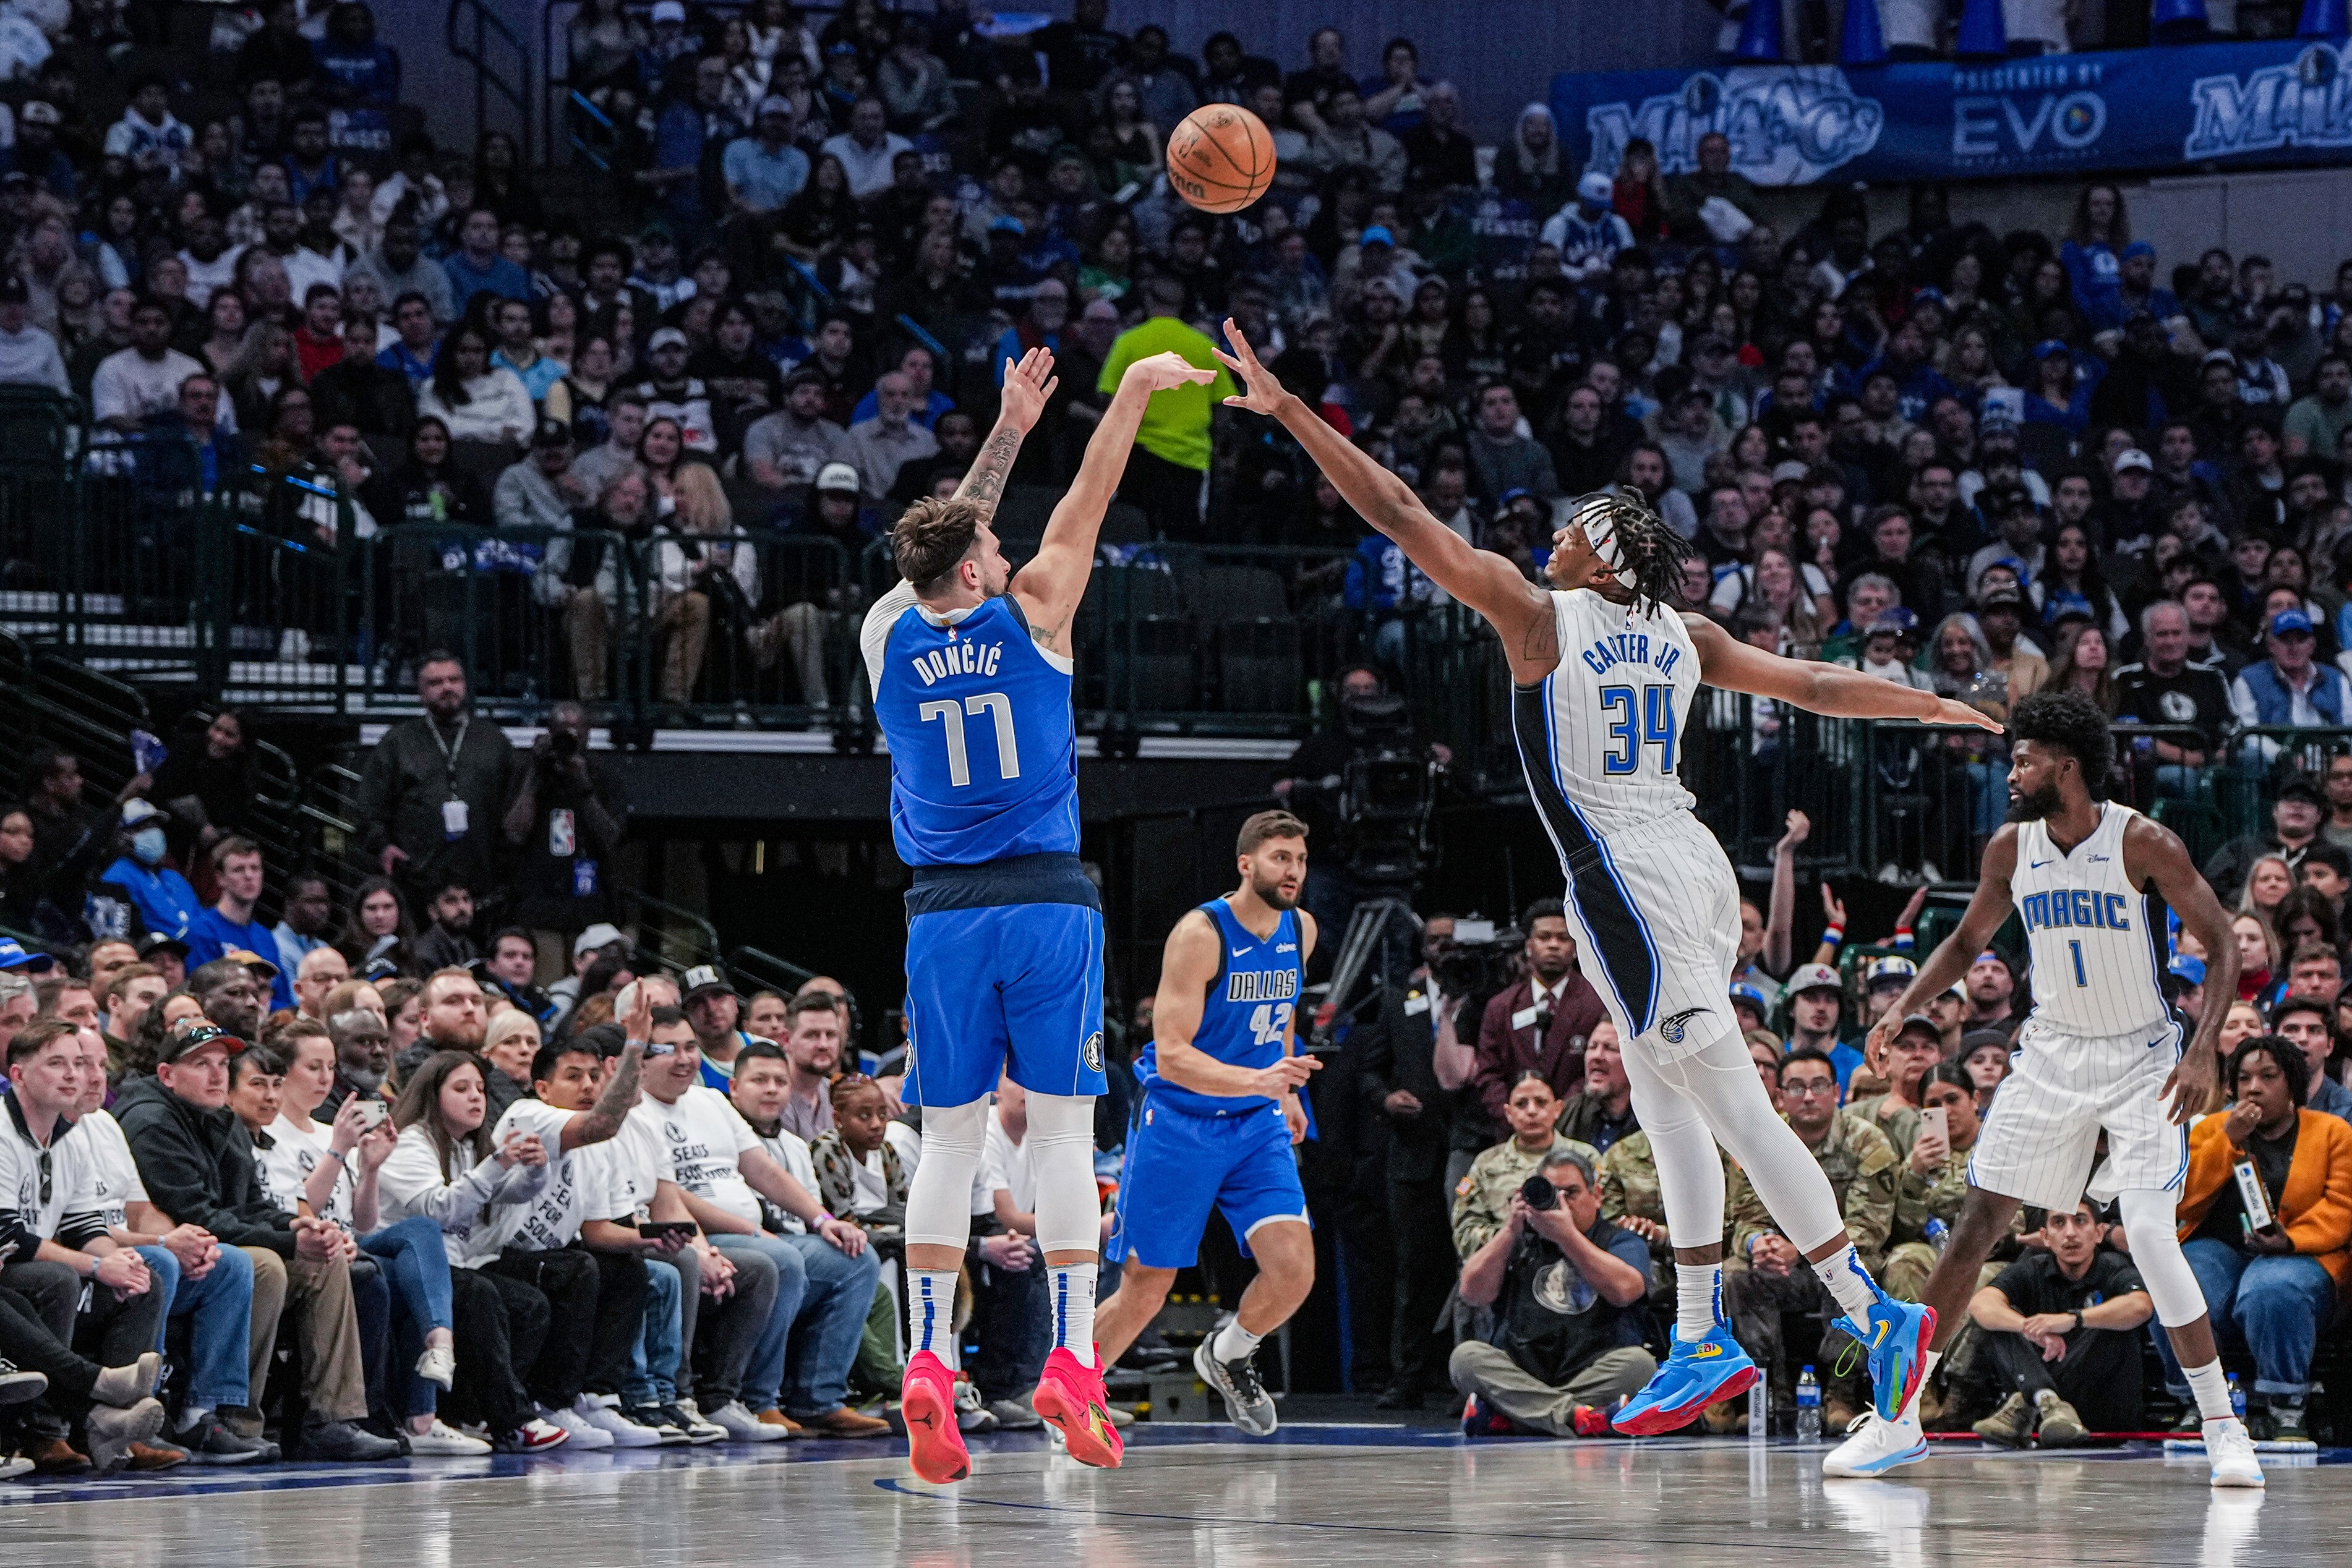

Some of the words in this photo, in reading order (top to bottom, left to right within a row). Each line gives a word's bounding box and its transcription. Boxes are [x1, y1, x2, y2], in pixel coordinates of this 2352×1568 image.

[1952, 90, 2106, 152] EVO
[912, 637, 1004, 686] DONČIĆ
[1583, 634, 1649, 675] CARTER
[1654, 642, 1680, 680] JR.
[919, 692, 1020, 786] 77
[1599, 684, 1677, 775] 34
[2022, 889, 2131, 934] MAGIC
[1226, 968, 1298, 1002] DALLAS
[2068, 939, 2087, 987] 1
[1249, 1002, 1293, 1046] 42
[673, 1144, 709, 1163] SEATS
